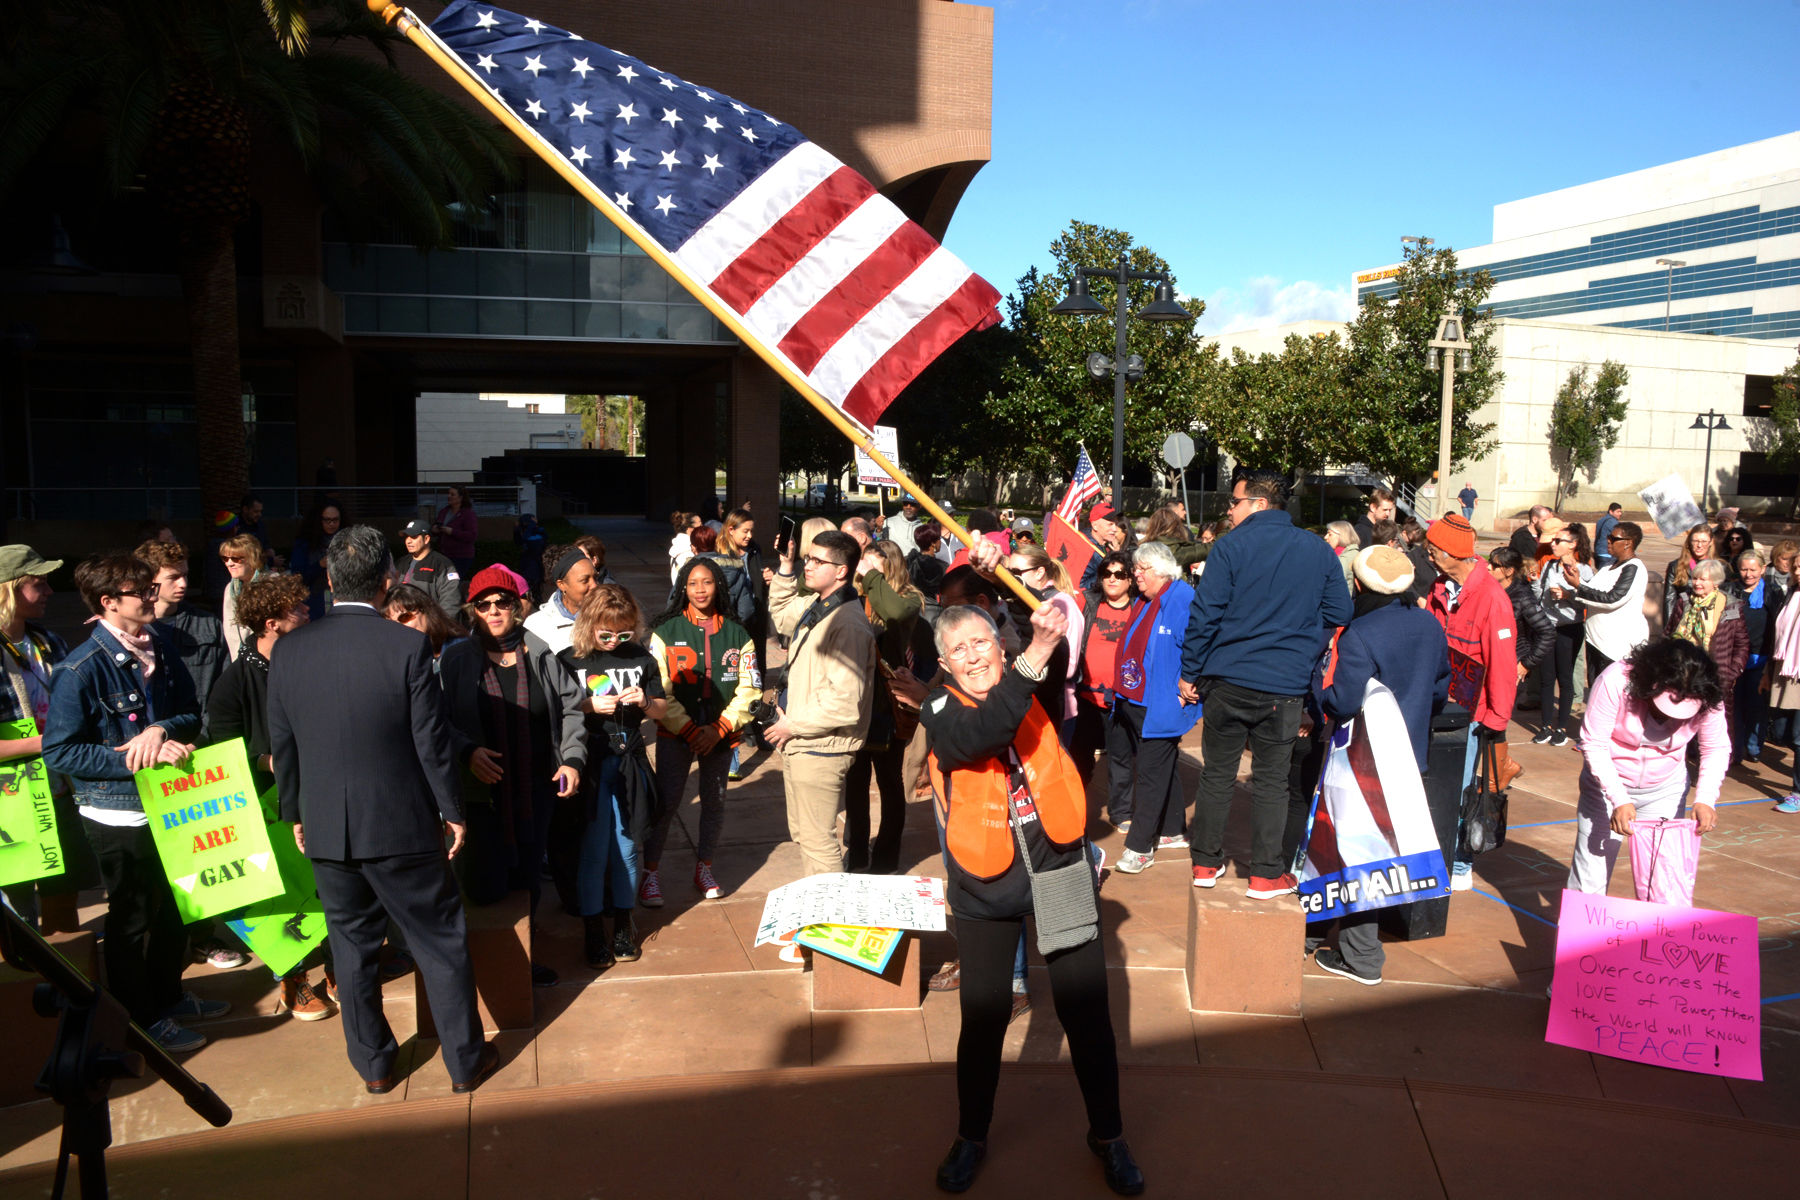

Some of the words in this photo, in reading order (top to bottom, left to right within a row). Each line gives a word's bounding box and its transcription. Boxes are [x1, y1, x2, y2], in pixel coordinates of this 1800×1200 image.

[1357, 272, 1382, 284] WELLS
[1450, 651, 1478, 682] WE
[160, 766, 229, 797] EQUAL
[33, 791, 54, 833] WHITE
[161, 791, 248, 830] RIGHTS
[192, 825, 238, 853] ARE
[40, 843, 61, 871] NOT
[200, 858, 247, 887] GAY
[1326, 880, 1360, 909] For
[834, 929, 860, 948] LA
[1585, 904, 1638, 932] When
[1653, 916, 1675, 938] the
[1690, 921, 1739, 945] Power
[1606, 935, 1623, 946] of
[1713, 980, 1741, 999] the
[1571, 1007, 1600, 1023] the
[1609, 1013, 1658, 1033] World
[1667, 1024, 1692, 1037] will
[1638, 994, 1659, 1006] of
[1669, 995, 1716, 1020] Power,
[1720, 1006, 1755, 1023] then
